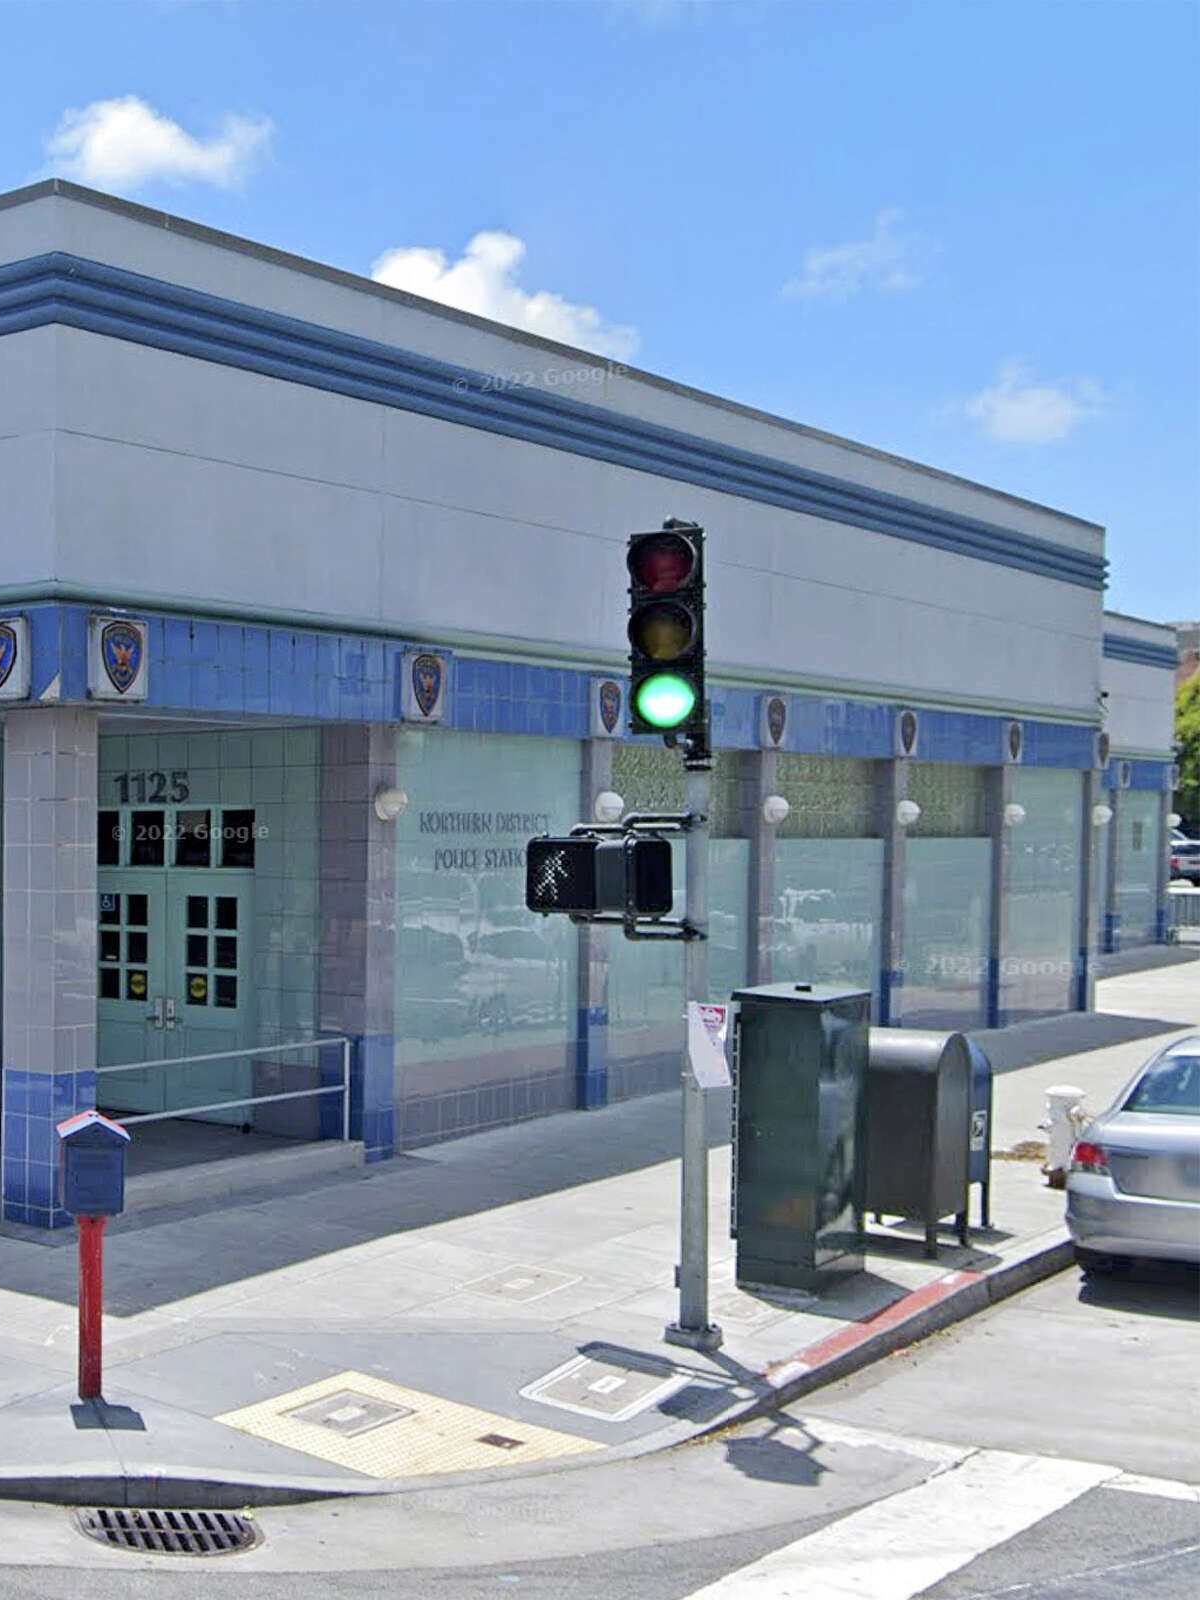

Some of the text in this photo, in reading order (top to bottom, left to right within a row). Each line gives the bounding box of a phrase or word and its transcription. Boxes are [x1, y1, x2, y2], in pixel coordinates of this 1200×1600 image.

[113, 770, 190, 804] 1125
[420, 810, 549, 834] NORTHERN DISTRICT
[434, 848, 477, 871] POLICE
